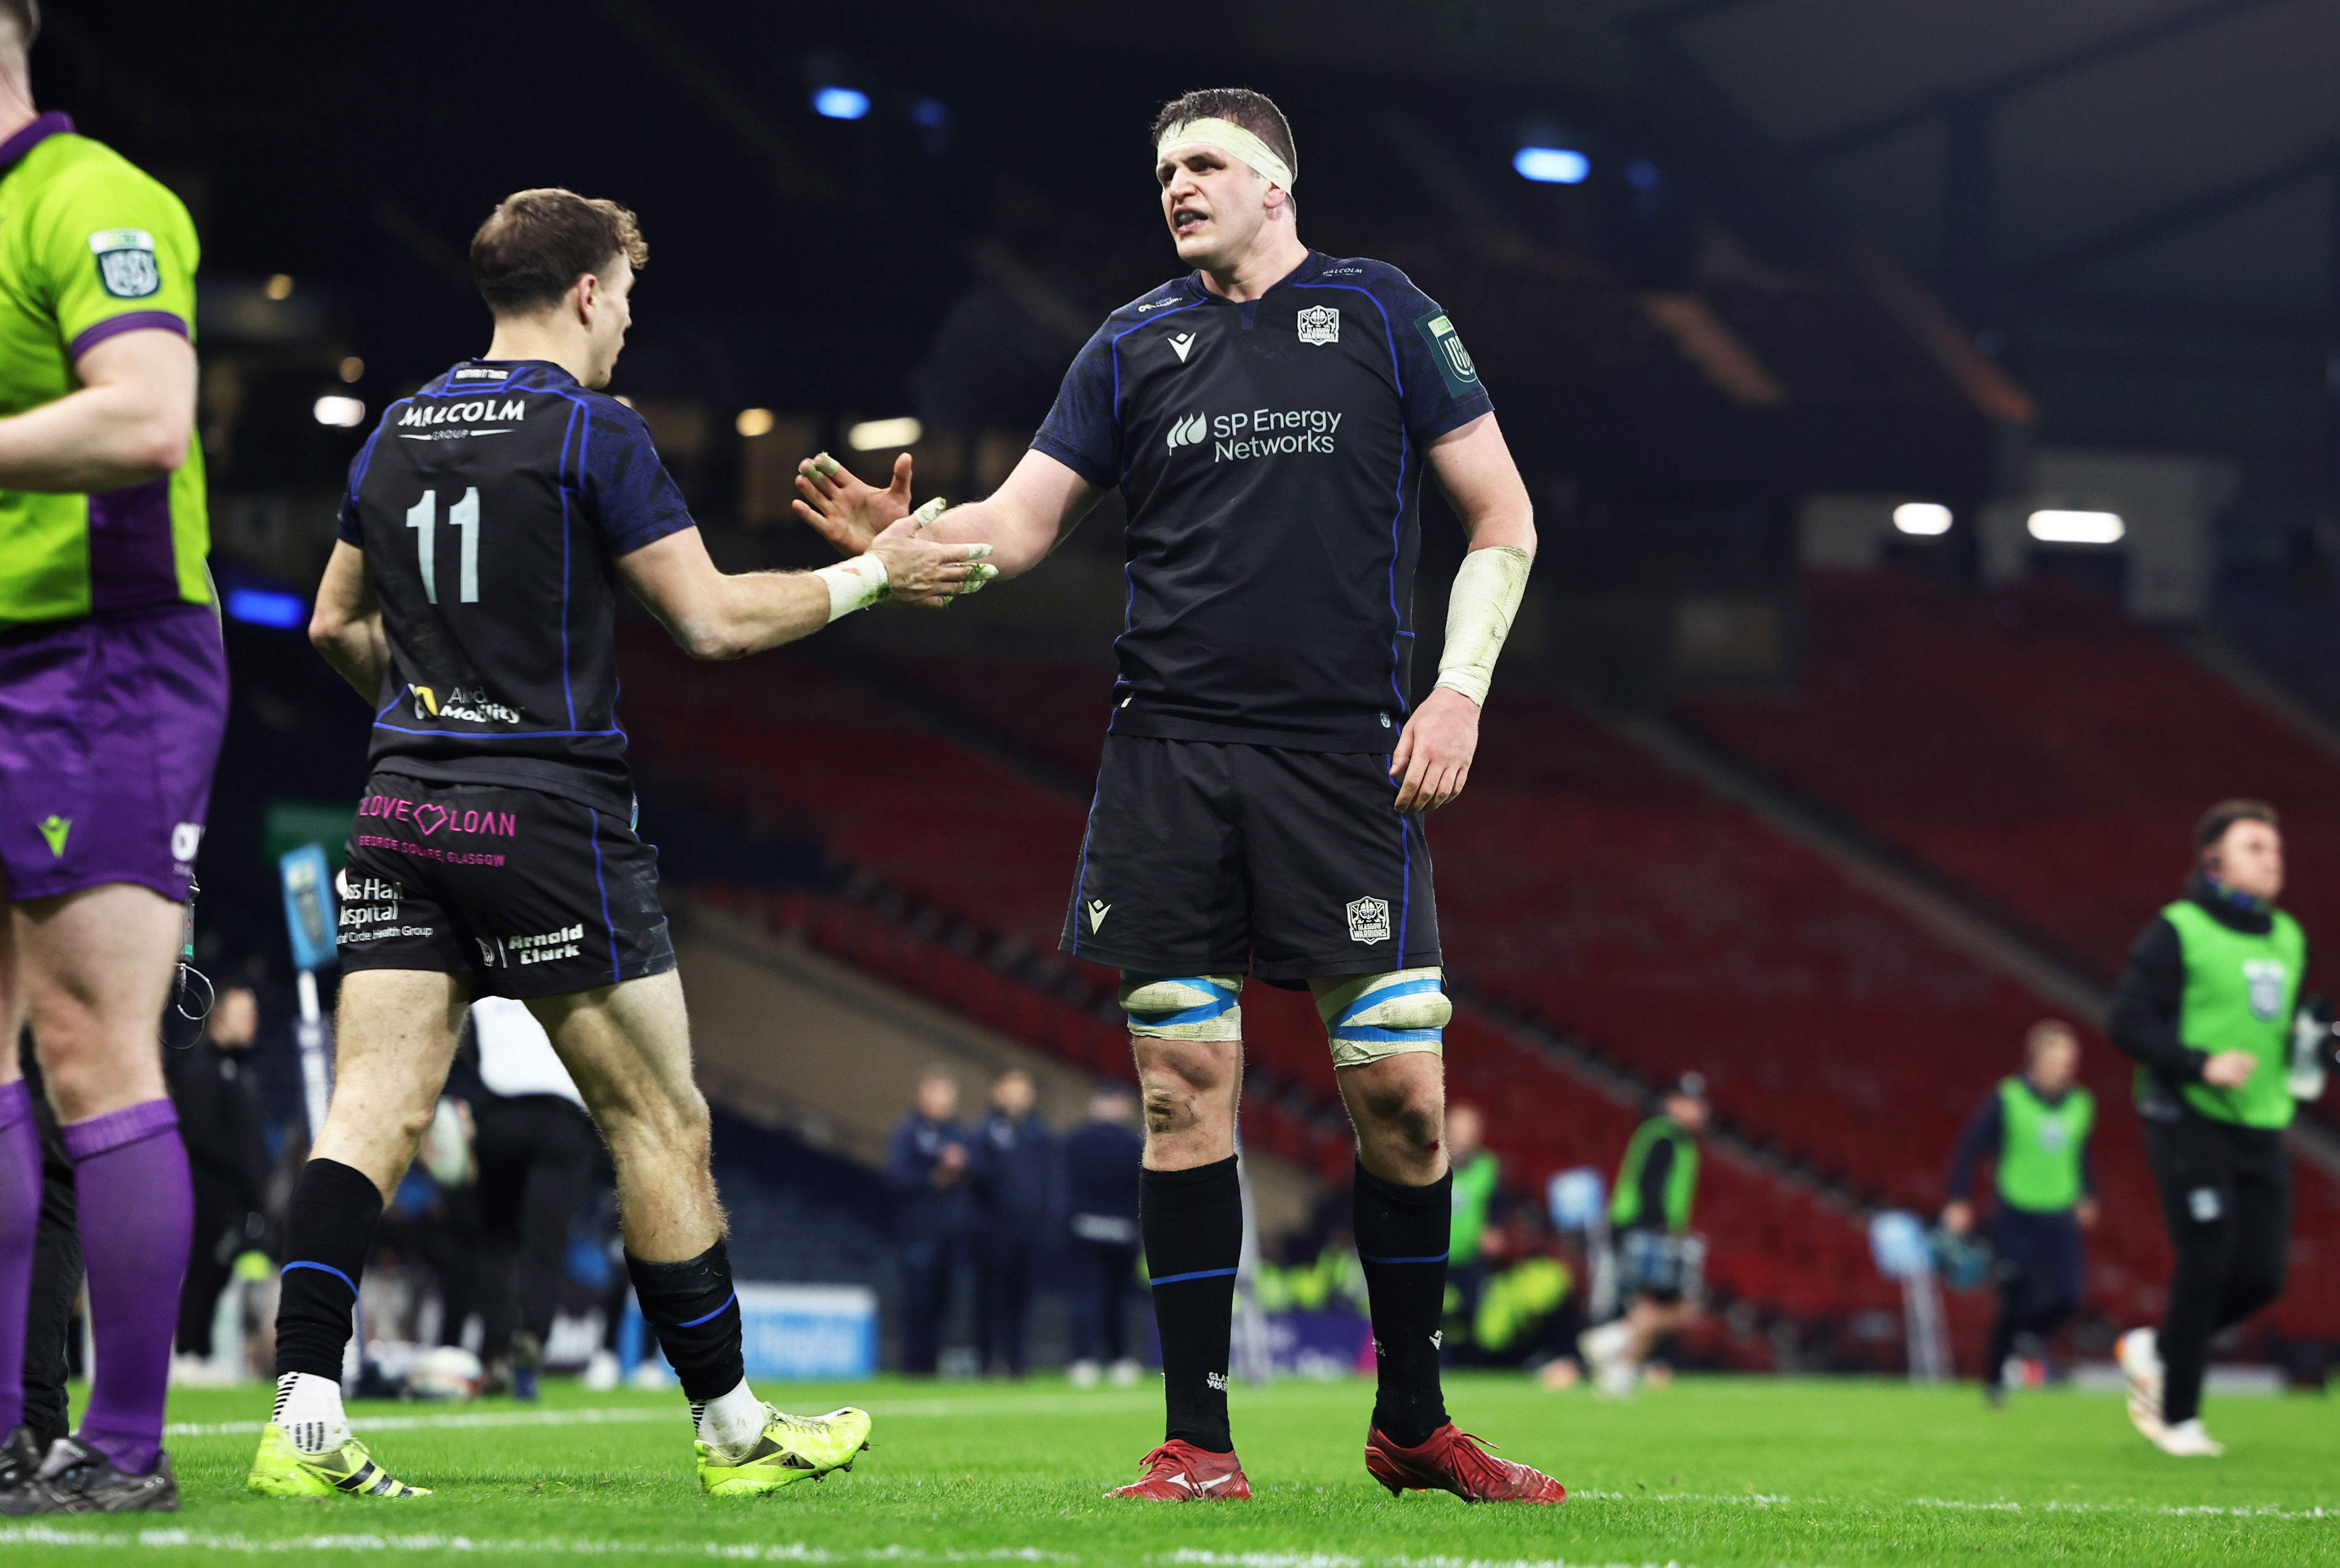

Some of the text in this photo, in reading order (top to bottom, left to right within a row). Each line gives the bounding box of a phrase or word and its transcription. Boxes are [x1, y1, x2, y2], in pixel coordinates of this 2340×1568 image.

[397, 399, 525, 427] MALCOLM
[1213, 409, 1342, 438] SP Energy
[432, 429, 470, 441] GROUP
[1215, 429, 1334, 463] Networks
[406, 486, 480, 604] 11
[359, 795, 516, 837] LOVE LOAN
[359, 835, 400, 851] GEORGE
[447, 851, 506, 868] GLASGOW
[402, 926, 434, 938] Group
[509, 923, 584, 949] Arnold
[1353, 929, 1387, 938] WARRIORS
[520, 943, 581, 965] Clark
